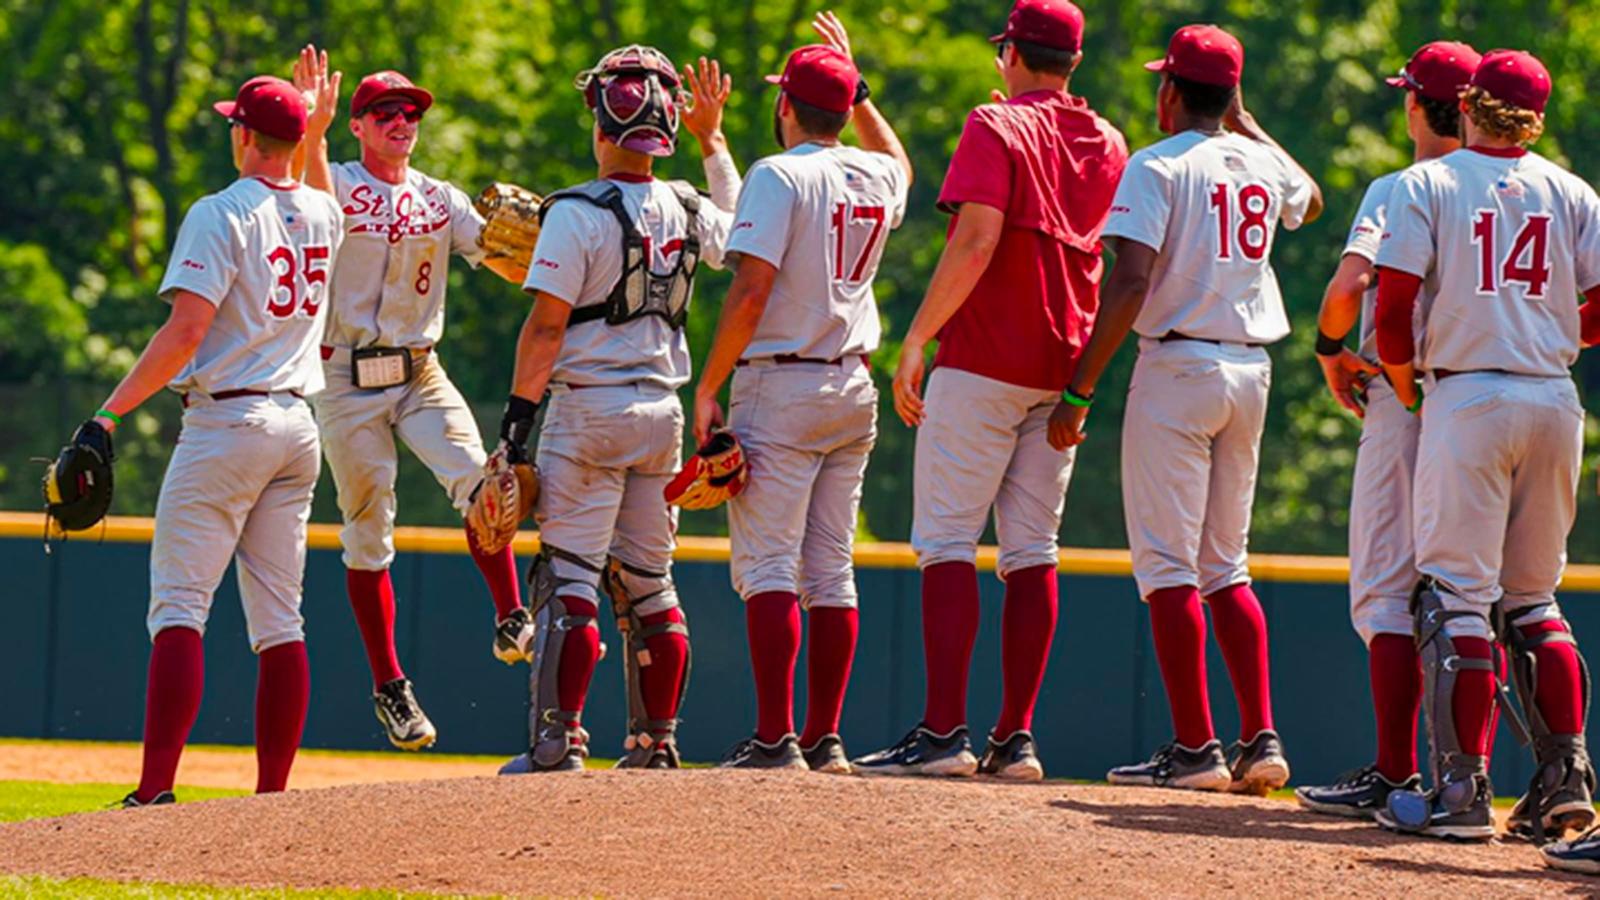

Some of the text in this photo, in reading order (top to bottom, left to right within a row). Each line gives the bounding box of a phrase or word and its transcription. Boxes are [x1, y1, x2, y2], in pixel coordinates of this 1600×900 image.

[342, 184, 391, 218] St.
[1210, 182, 1270, 261] 18
[415, 261, 432, 295] 8
[831, 202, 886, 281] 17
[1471, 210, 1552, 297] 14
[266, 245, 329, 318] 35
